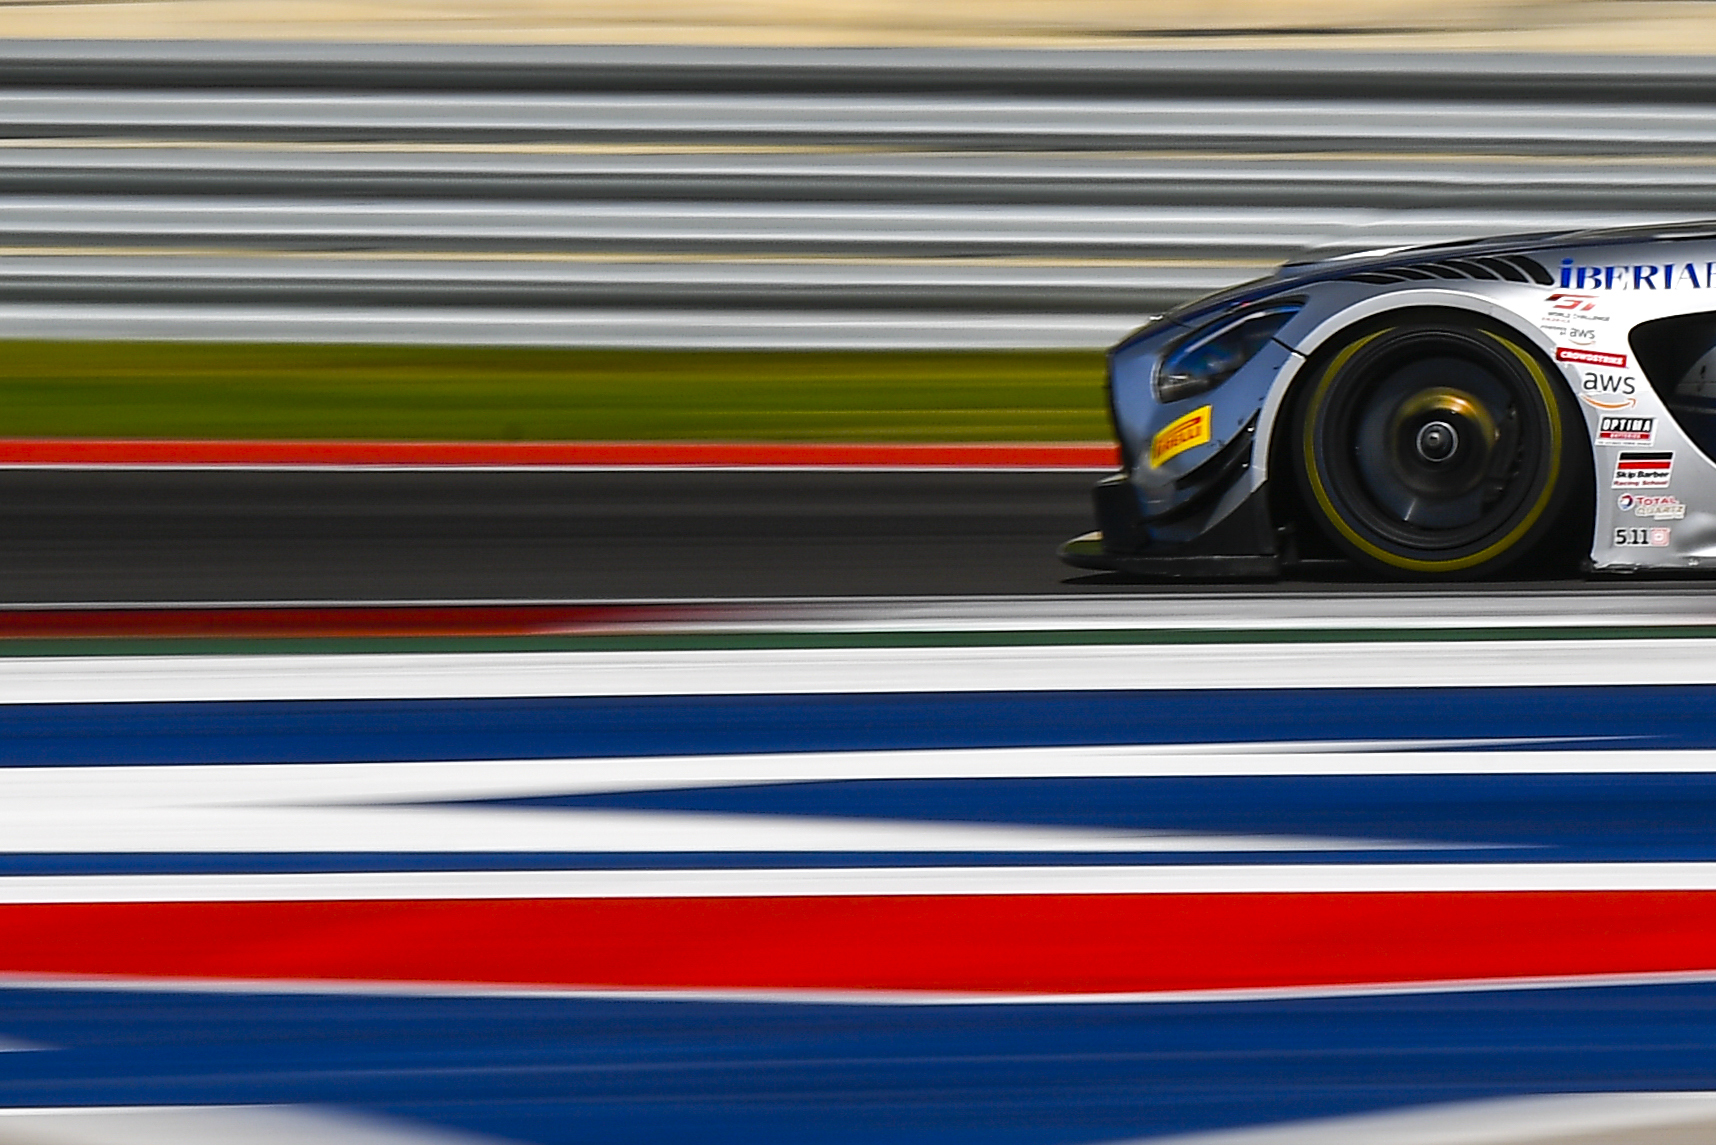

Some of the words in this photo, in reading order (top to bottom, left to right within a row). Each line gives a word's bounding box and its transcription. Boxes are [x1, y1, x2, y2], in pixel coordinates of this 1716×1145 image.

[1569, 328, 1596, 340] aws
[1560, 351, 1624, 365] CROWDSTRIKE
[1583, 372, 1636, 395] aws
[1602, 418, 1652, 432] OPTIMA
[1616, 471, 1636, 479] Skip
[1637, 470, 1669, 478] Barber
[1636, 496, 1678, 506] TOTAL
[1615, 529, 1649, 545] 5.11
